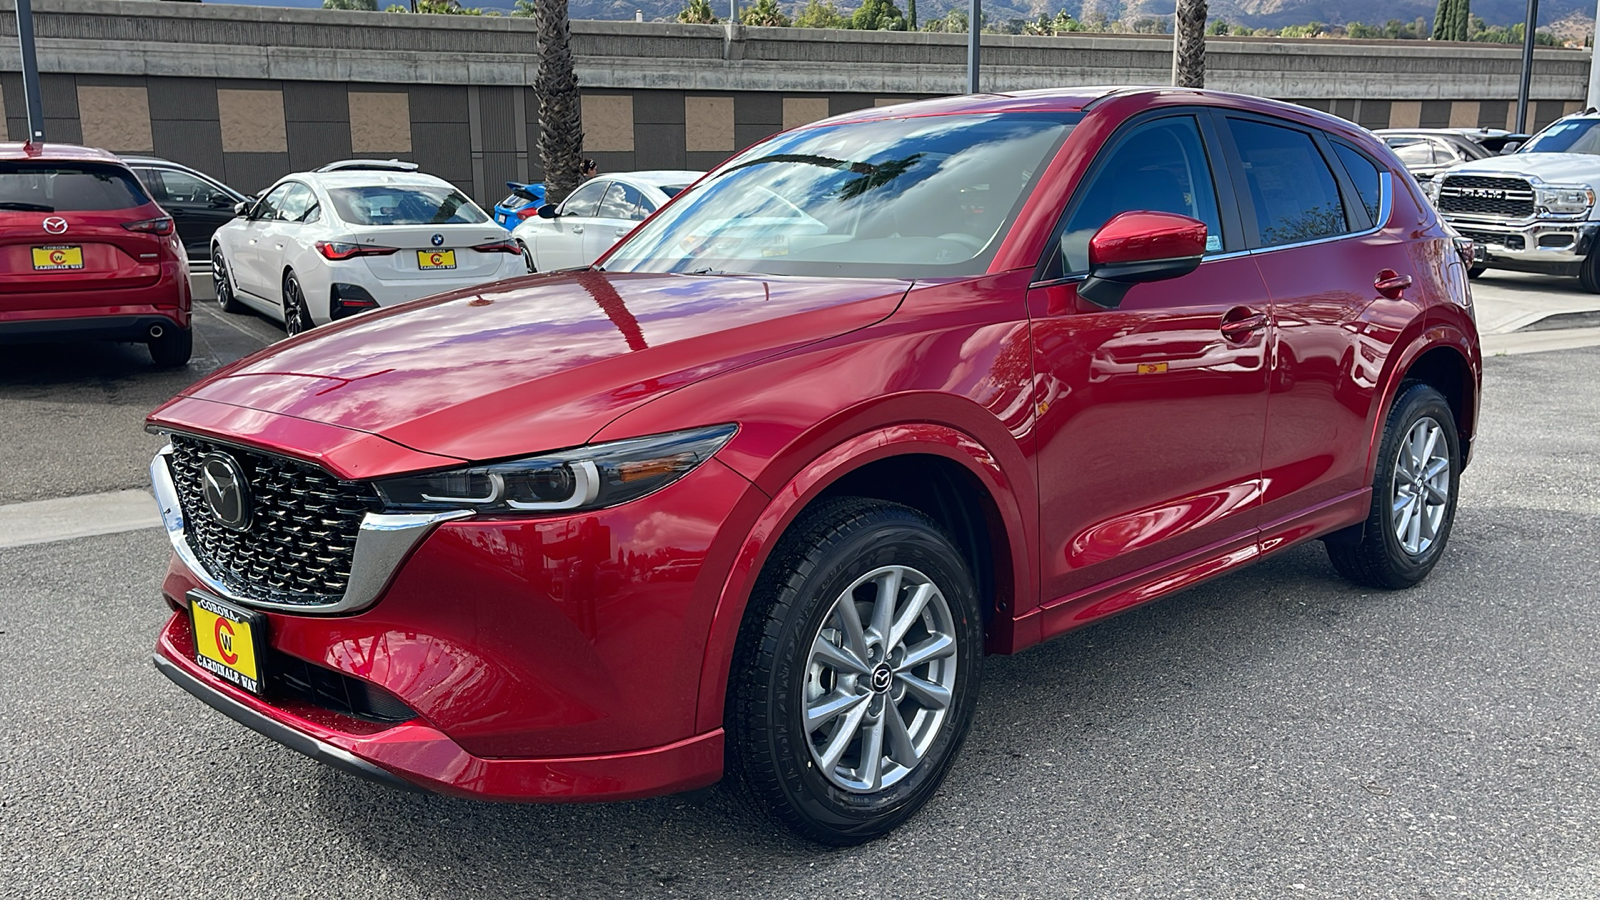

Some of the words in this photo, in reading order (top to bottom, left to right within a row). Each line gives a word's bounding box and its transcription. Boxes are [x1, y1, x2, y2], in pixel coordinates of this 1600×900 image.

[49, 250, 67, 265] C
[430, 253, 443, 266] C
[201, 599, 236, 620] CORONA
[214, 617, 239, 665] C
[220, 633, 232, 652] W
[197, 655, 240, 683] CARDINALE
[241, 676, 258, 693] WAY
